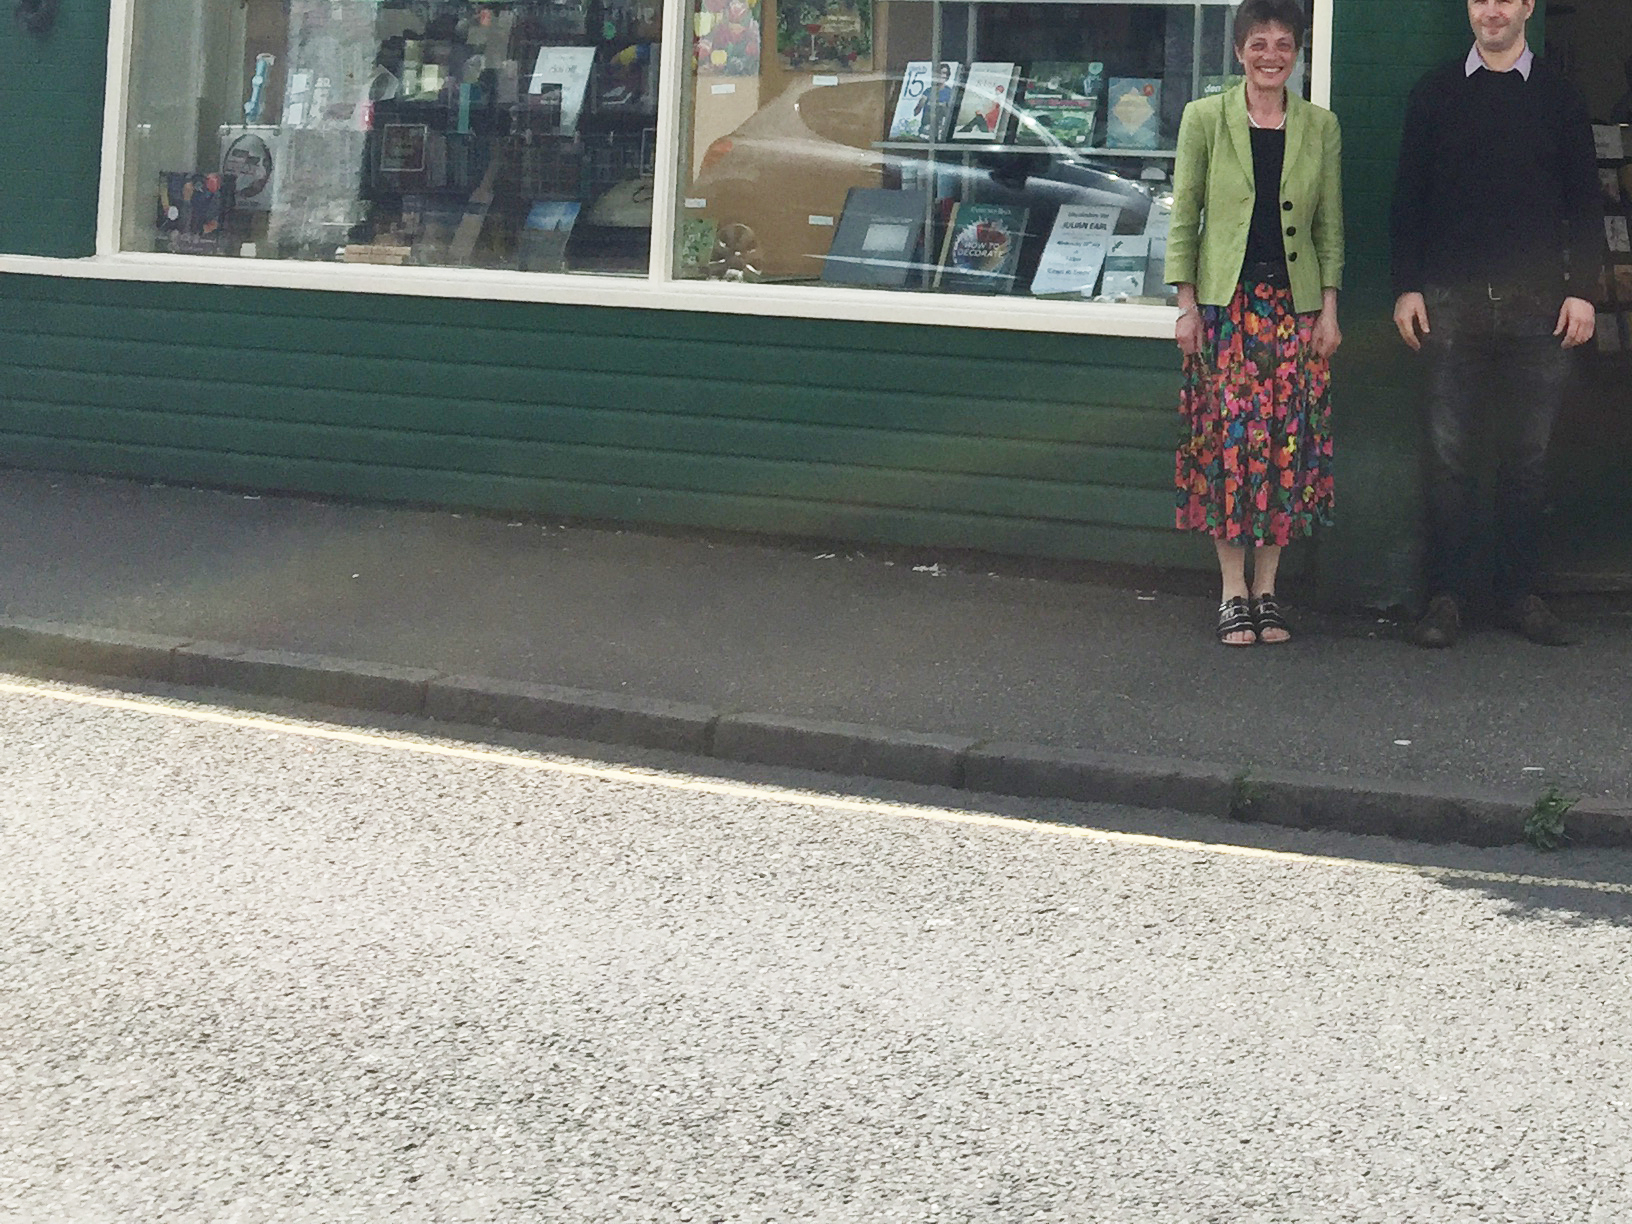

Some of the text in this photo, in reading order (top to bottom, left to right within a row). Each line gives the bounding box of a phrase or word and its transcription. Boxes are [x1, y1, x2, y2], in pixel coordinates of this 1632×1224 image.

[903, 70, 928, 97] 15
[963, 242, 1000, 250] HOW TO
[957, 249, 1005, 257] DECORATE
